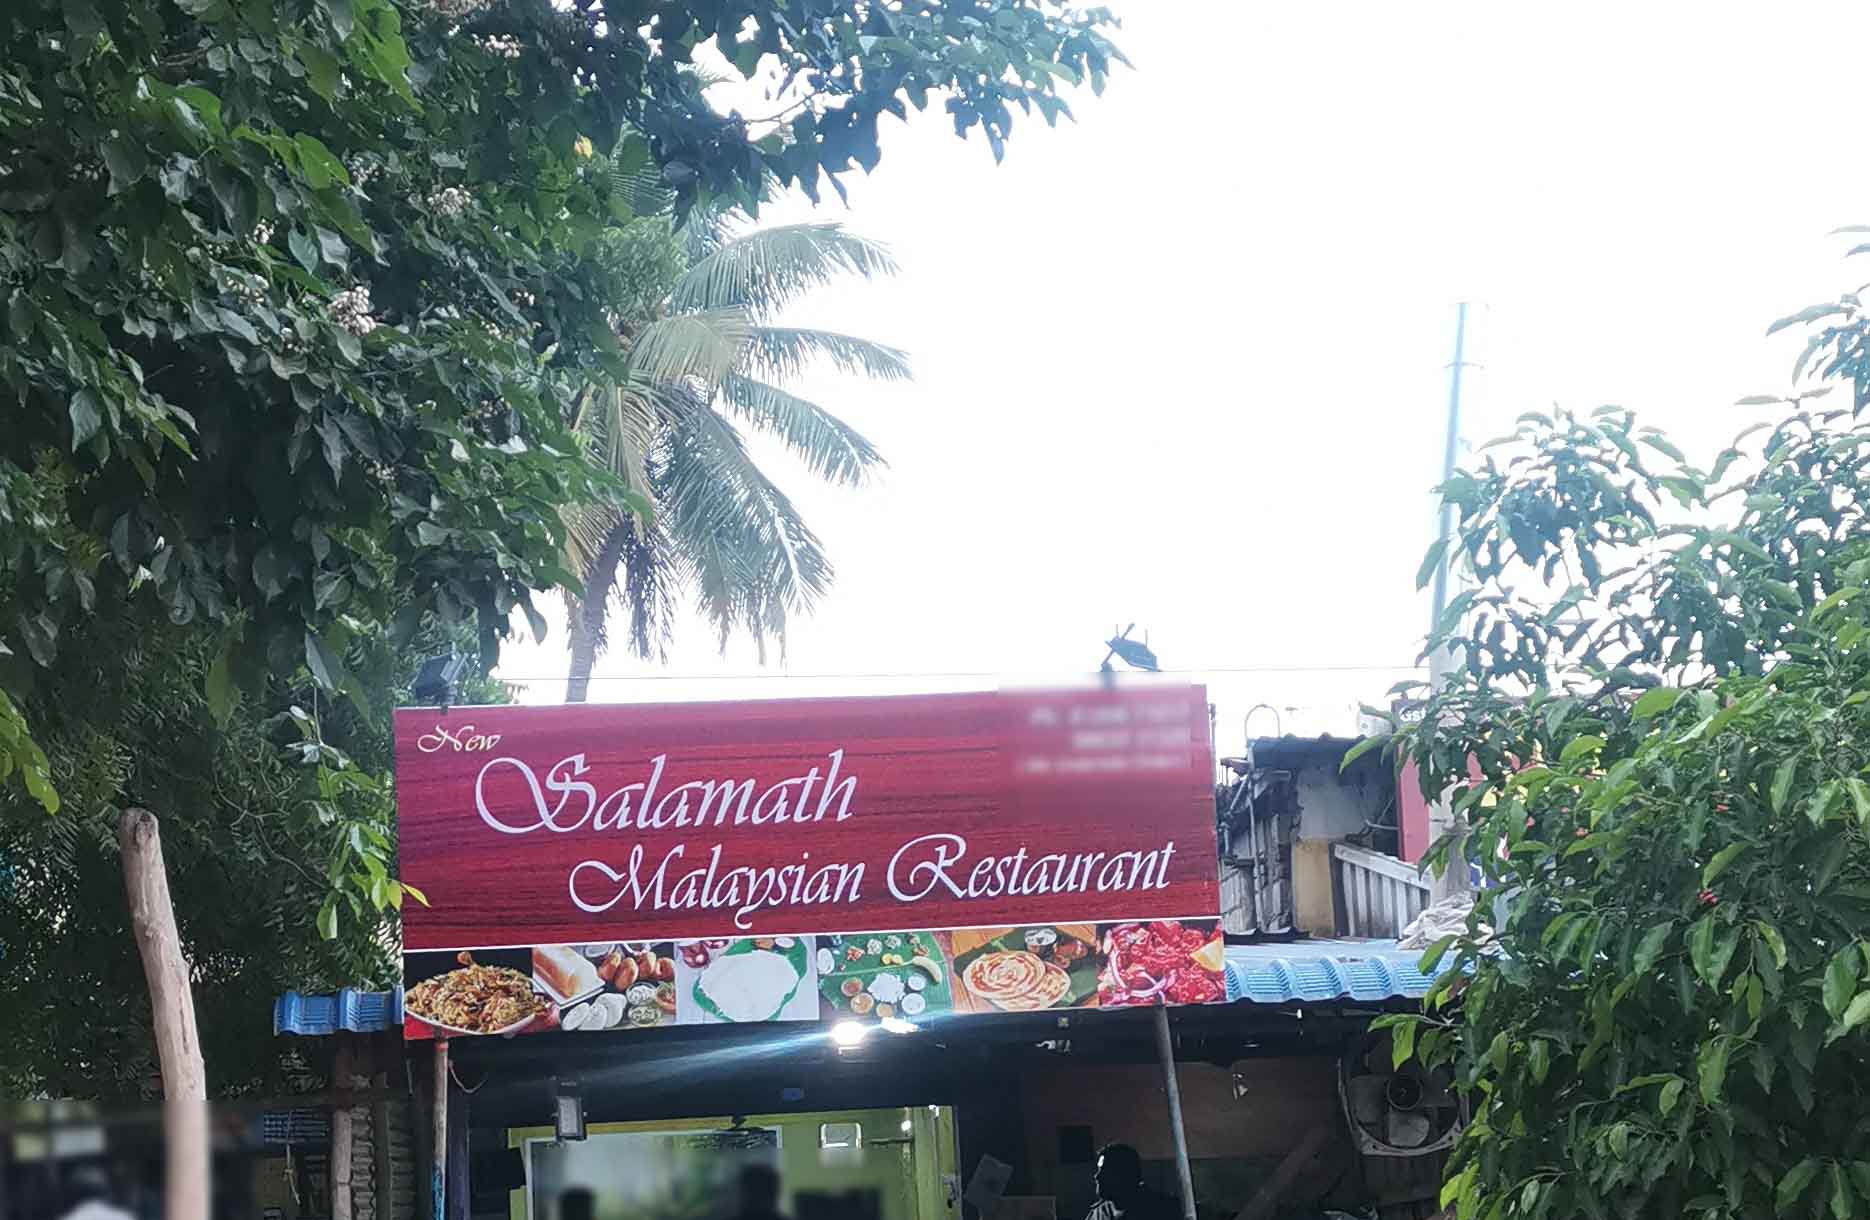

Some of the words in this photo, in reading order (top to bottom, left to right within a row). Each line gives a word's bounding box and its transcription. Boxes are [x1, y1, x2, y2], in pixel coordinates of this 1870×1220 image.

[417, 724, 501, 752] New
[475, 749, 858, 835] Salamath
[569, 844, 866, 930] Malaysian
[886, 833, 1177, 902] Restaurant
